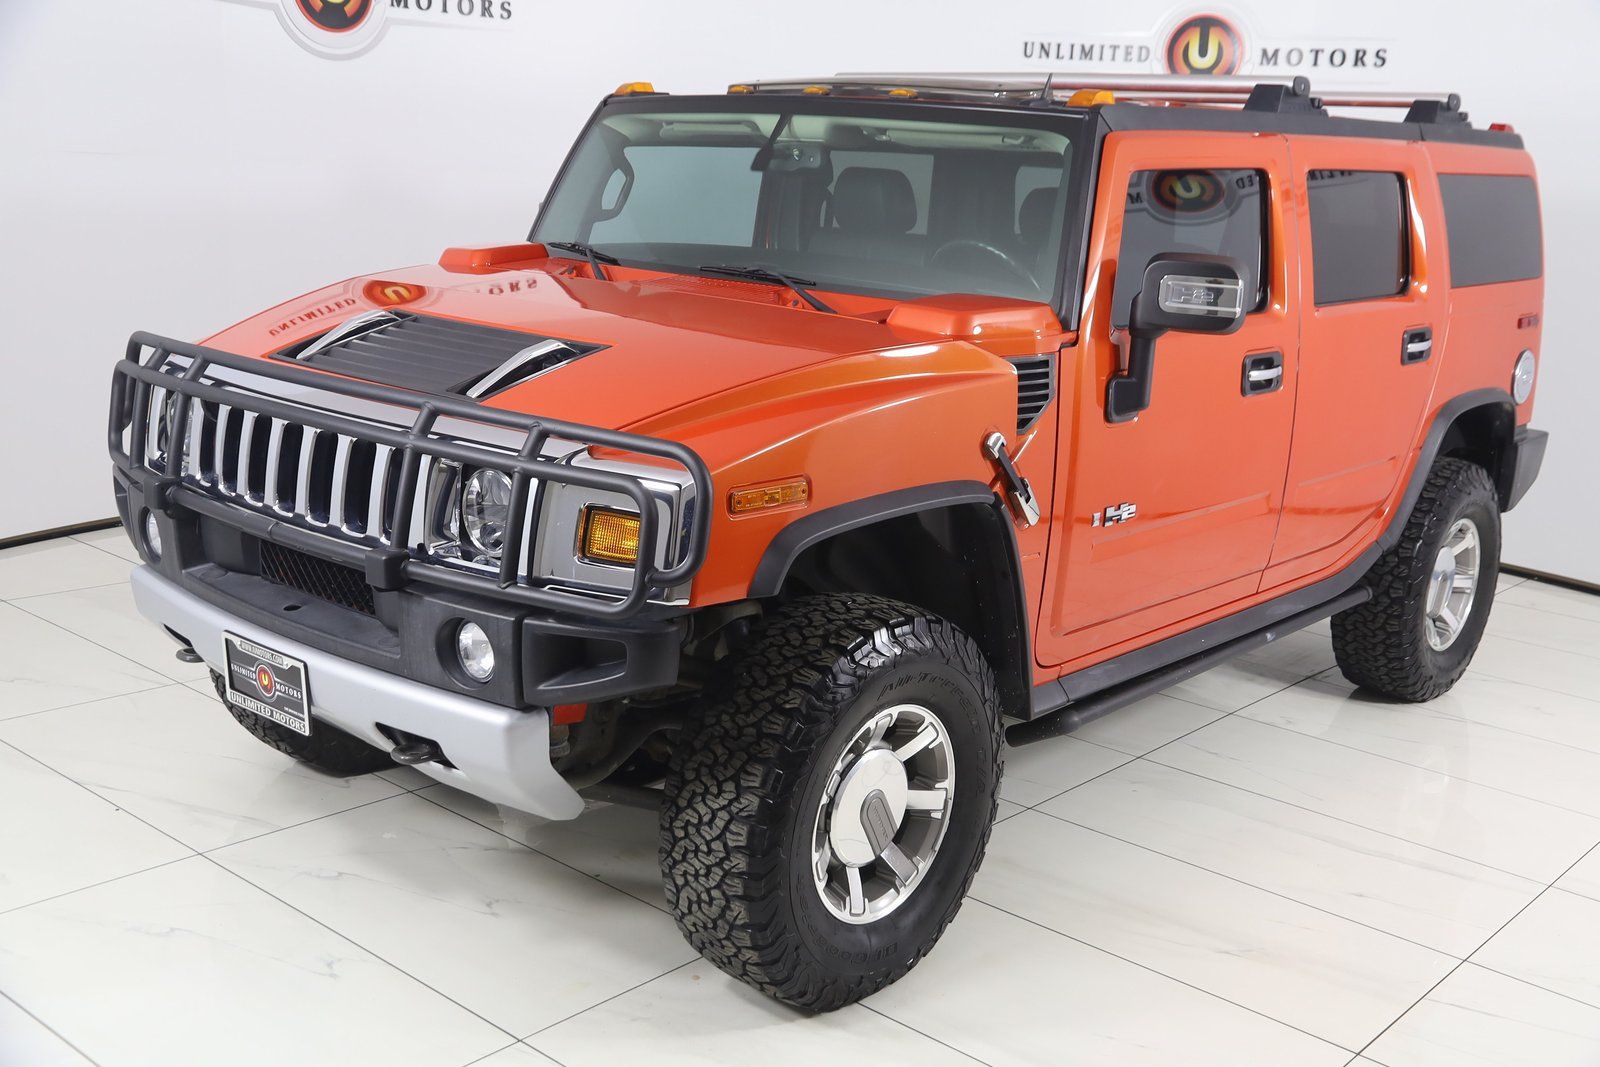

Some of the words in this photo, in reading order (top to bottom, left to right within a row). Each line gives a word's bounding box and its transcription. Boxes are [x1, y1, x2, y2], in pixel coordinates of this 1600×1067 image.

[1021, 41, 1151, 63] UNLIMITED
[1259, 47, 1389, 68] MOTORS
[231, 664, 256, 680] UNLIMITED
[276, 683, 302, 699] MOTORS
[230, 692, 271, 716] UNLIMITED
[273, 713, 305, 732] MOTORS
